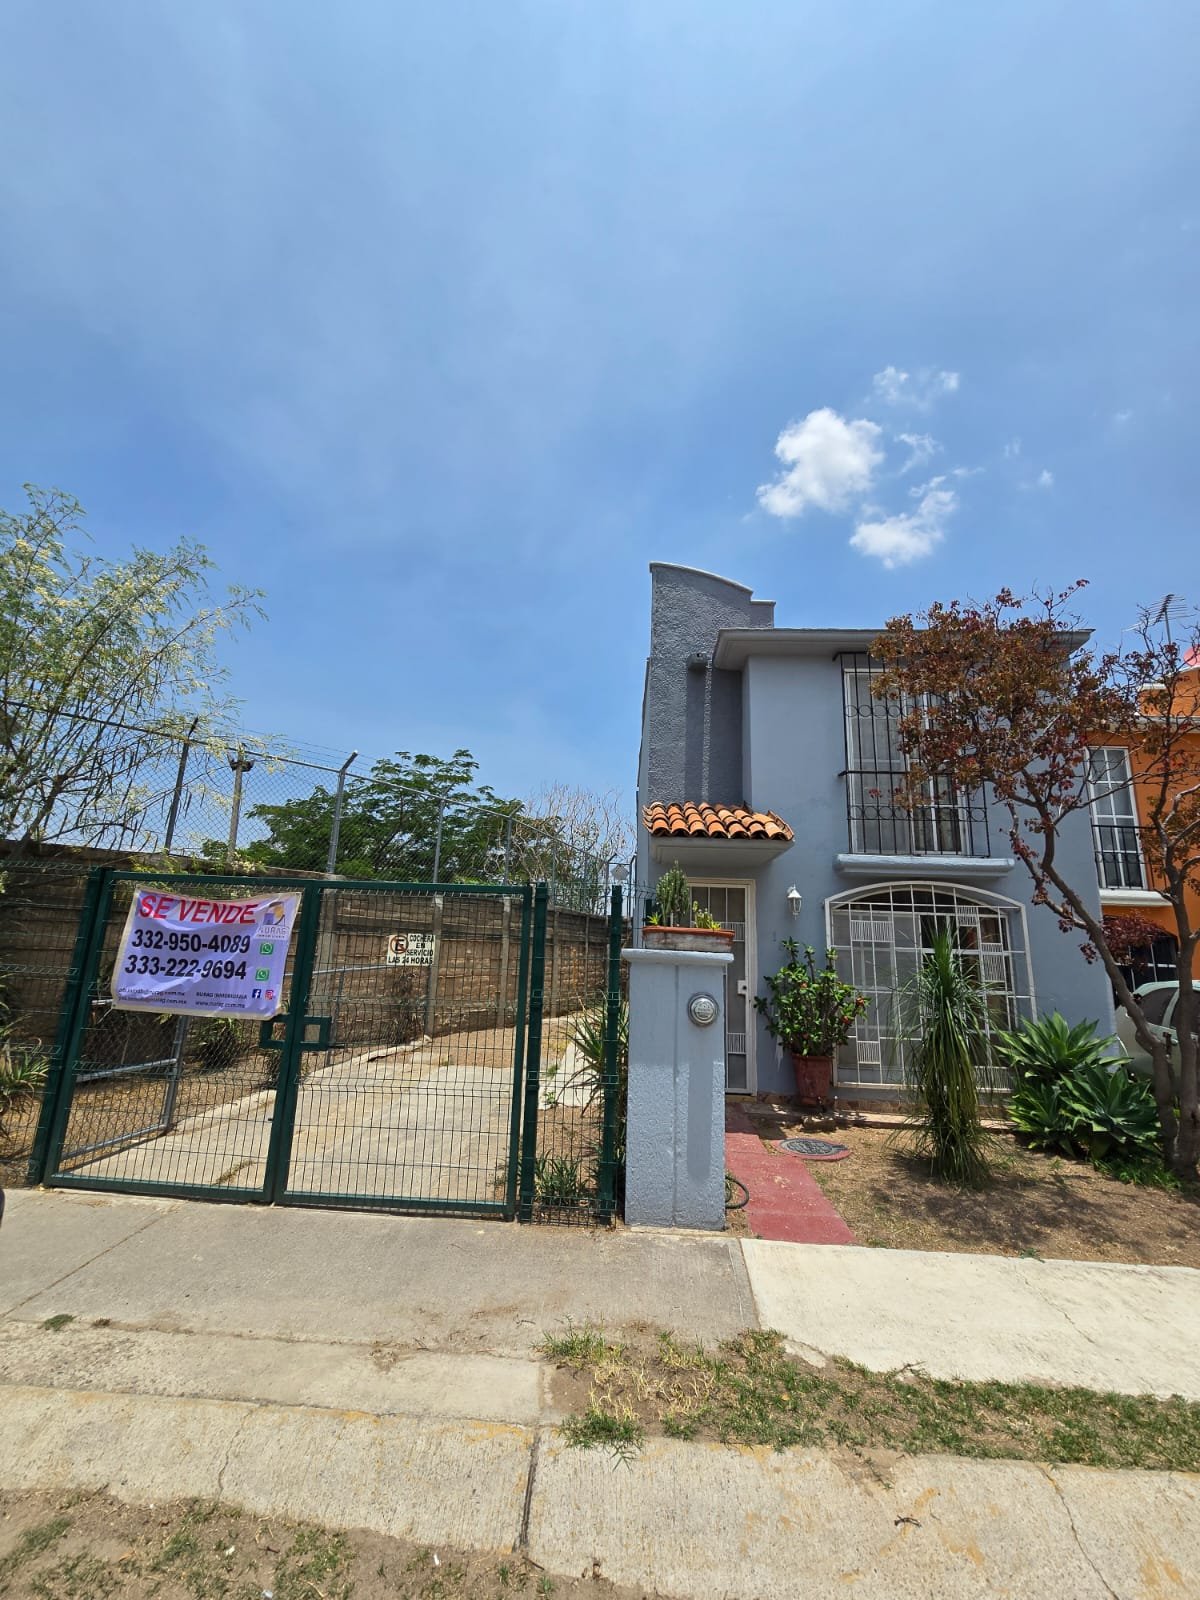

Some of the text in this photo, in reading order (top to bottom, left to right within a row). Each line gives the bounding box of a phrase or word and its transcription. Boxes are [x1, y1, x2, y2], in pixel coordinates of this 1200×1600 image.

[138, 895, 258, 924] SE VENDE
[132, 929, 251, 953] 332-950-4089
[124, 954, 247, 980] 333-222-9694
